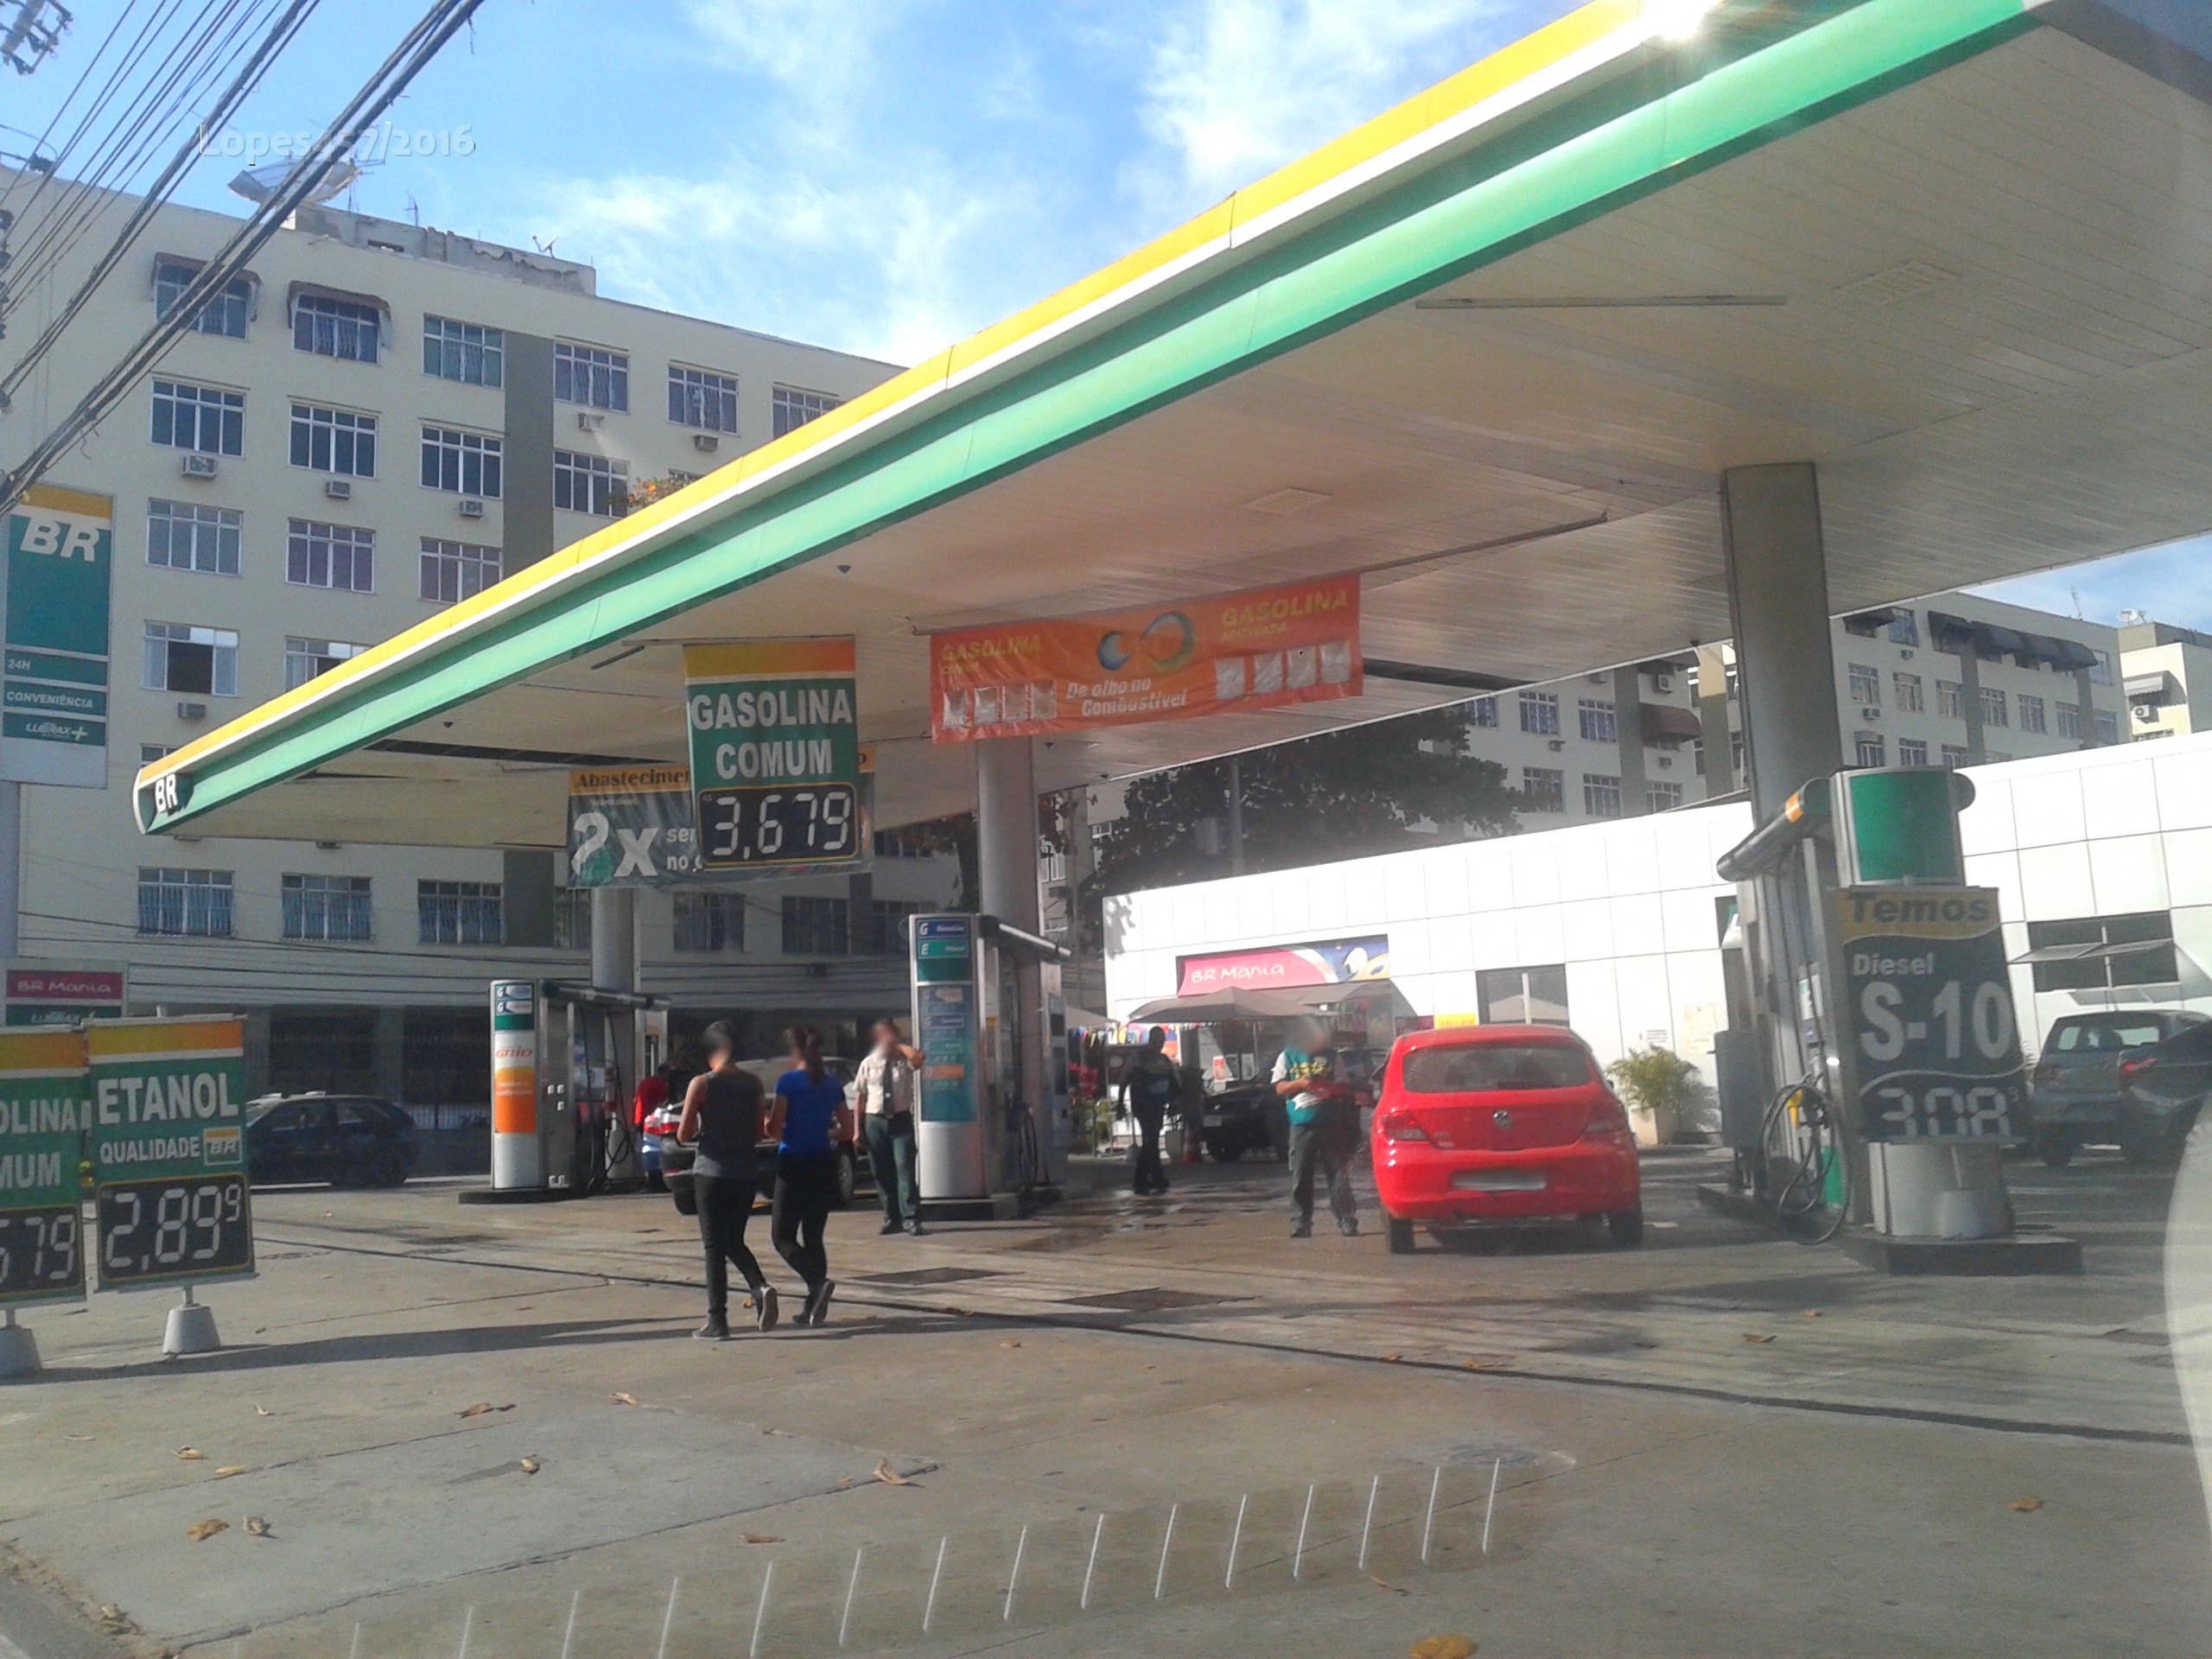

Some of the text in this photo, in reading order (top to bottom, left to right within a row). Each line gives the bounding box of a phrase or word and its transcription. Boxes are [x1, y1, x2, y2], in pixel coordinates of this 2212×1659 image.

[19, 517, 100, 562] BR
[1220, 588, 1348, 627] GASOLINA
[8, 658, 32, 671] 24H
[1065, 677, 1152, 700] De olho no
[691, 688, 854, 731] GASOLINA
[715, 739, 833, 780] COMUM
[155, 773, 178, 812] BR
[1847, 892, 1990, 923] Temos
[1191, 963, 1285, 983] BR Mania
[1853, 952, 1935, 976] Diesel
[1859, 980, 2015, 1062] S-10
[97, 1071, 239, 1126] ETANOL
[99, 1135, 237, 1166] QUALIDADE BR
